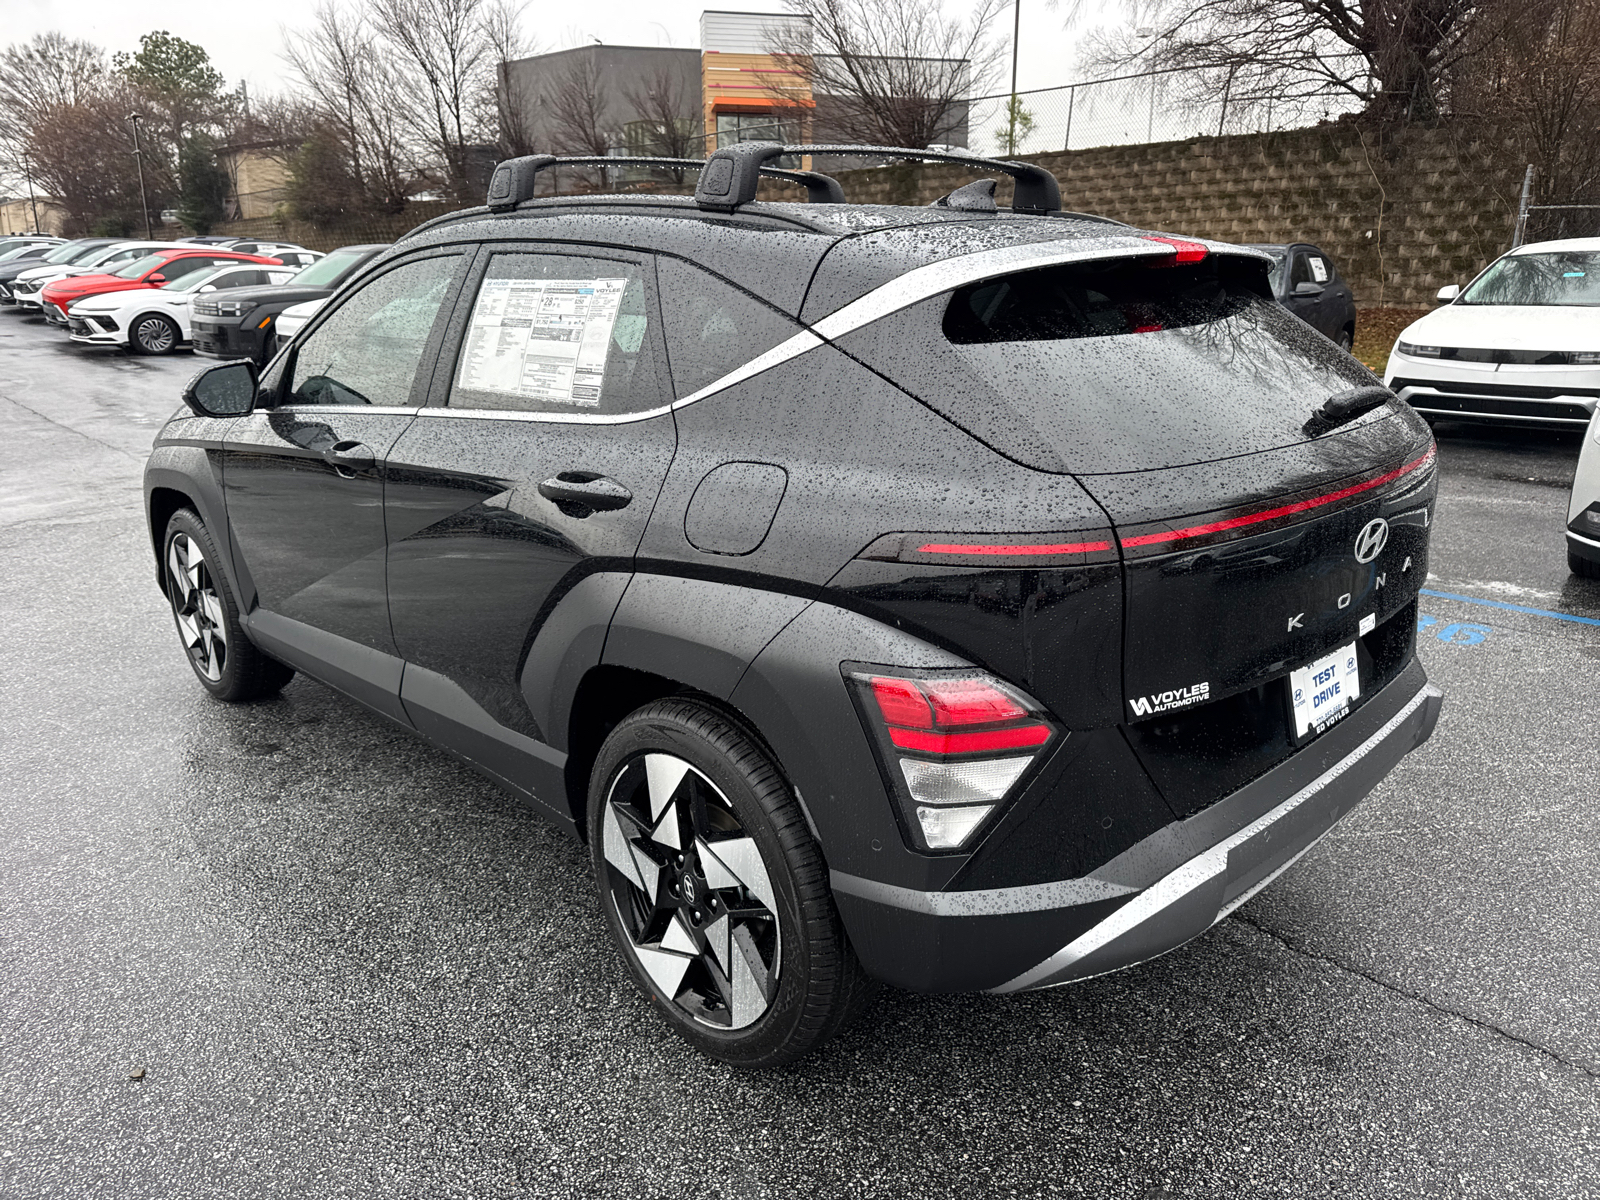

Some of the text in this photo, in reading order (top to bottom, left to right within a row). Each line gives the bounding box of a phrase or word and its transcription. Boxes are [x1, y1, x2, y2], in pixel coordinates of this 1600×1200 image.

[544, 297, 553, 306] 28
[1312, 664, 1336, 687] TEST
[1151, 681, 1210, 705] VOYLES
[1153, 692, 1210, 713] AUTOMOTIVE
[1313, 681, 1341, 709] DRIVE
[1316, 722, 1325, 734] ED
[1325, 706, 1350, 727] VOYLES
